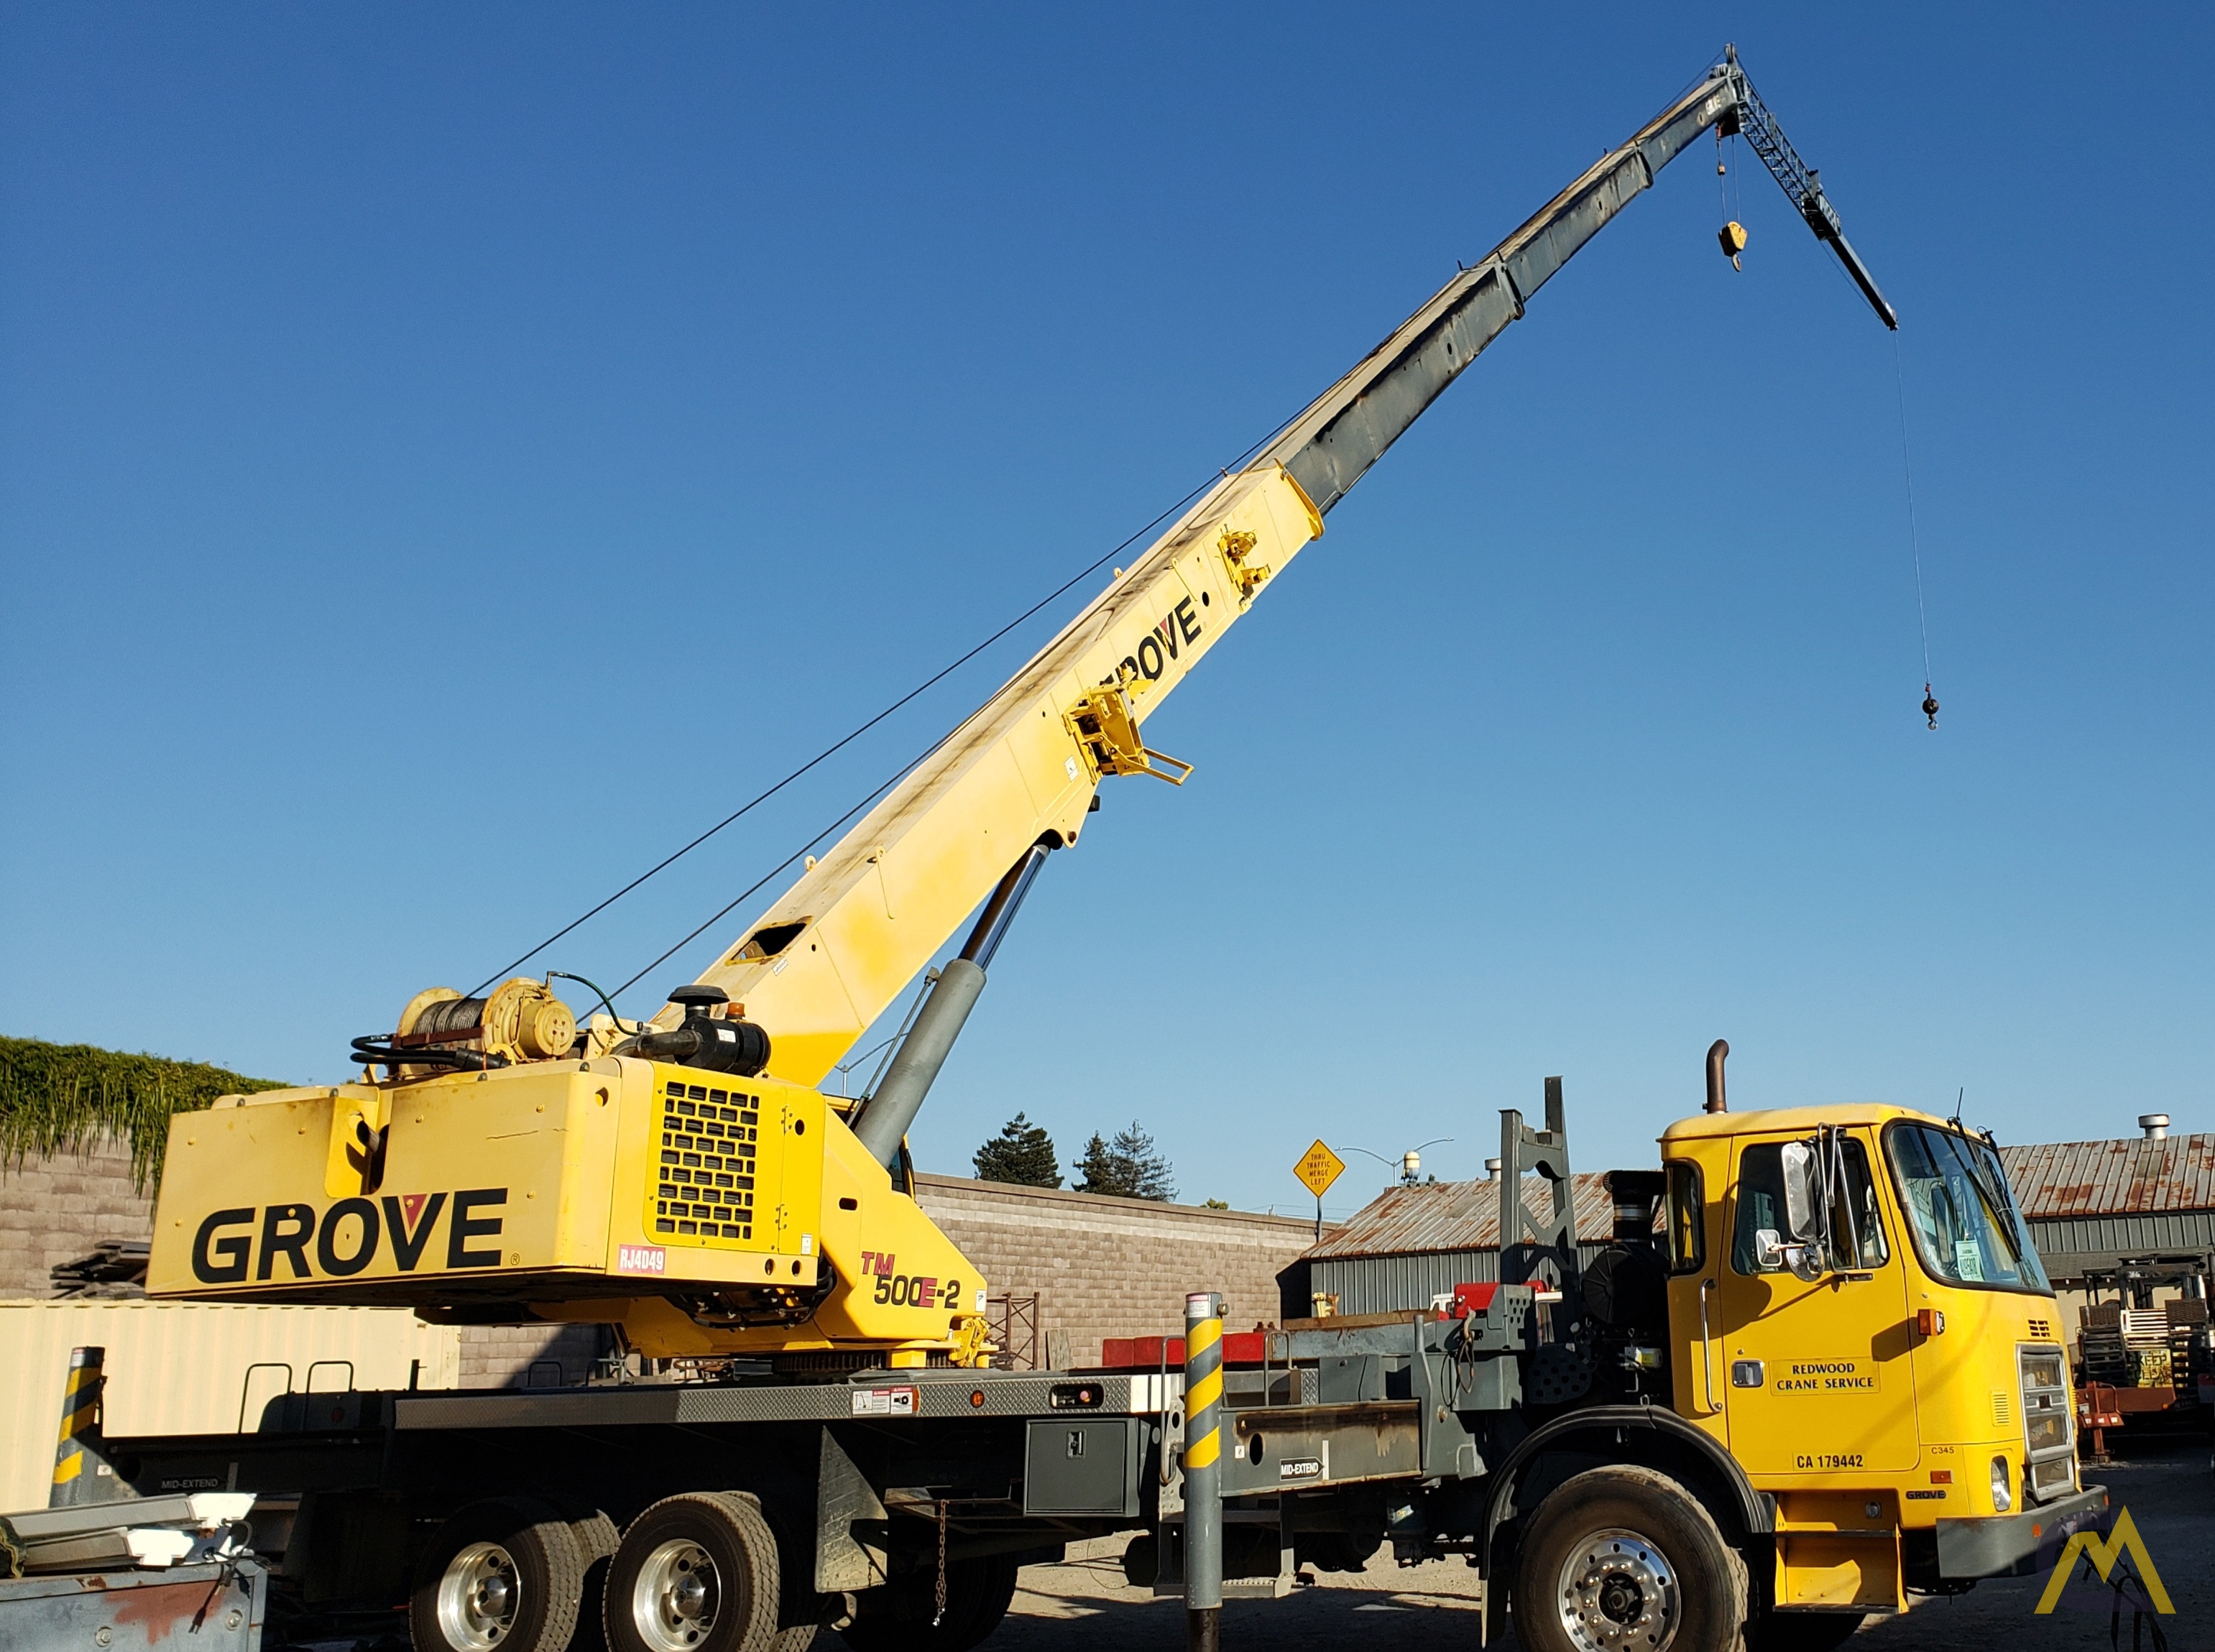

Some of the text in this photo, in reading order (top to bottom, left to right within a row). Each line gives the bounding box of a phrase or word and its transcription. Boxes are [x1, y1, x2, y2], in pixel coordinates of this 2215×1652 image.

[1100, 594, 1202, 685] ROVE
[1307, 1160, 1330, 1169] TRAFFIC
[191, 1187, 509, 1284] GROVE
[861, 1250, 895, 1277] TM
[874, 1274, 961, 1309] 500E-2
[1792, 1362, 1856, 1375] REDWOOD
[1777, 1377, 1874, 1390] CRANE SERVICE
[1797, 1454, 1864, 1468] CA 179442
[1281, 1462, 1319, 1475] MID-EXTEND
[161, 1478, 218, 1489] MID-EXTEND
[1906, 1490, 1946, 1500] GROVE
